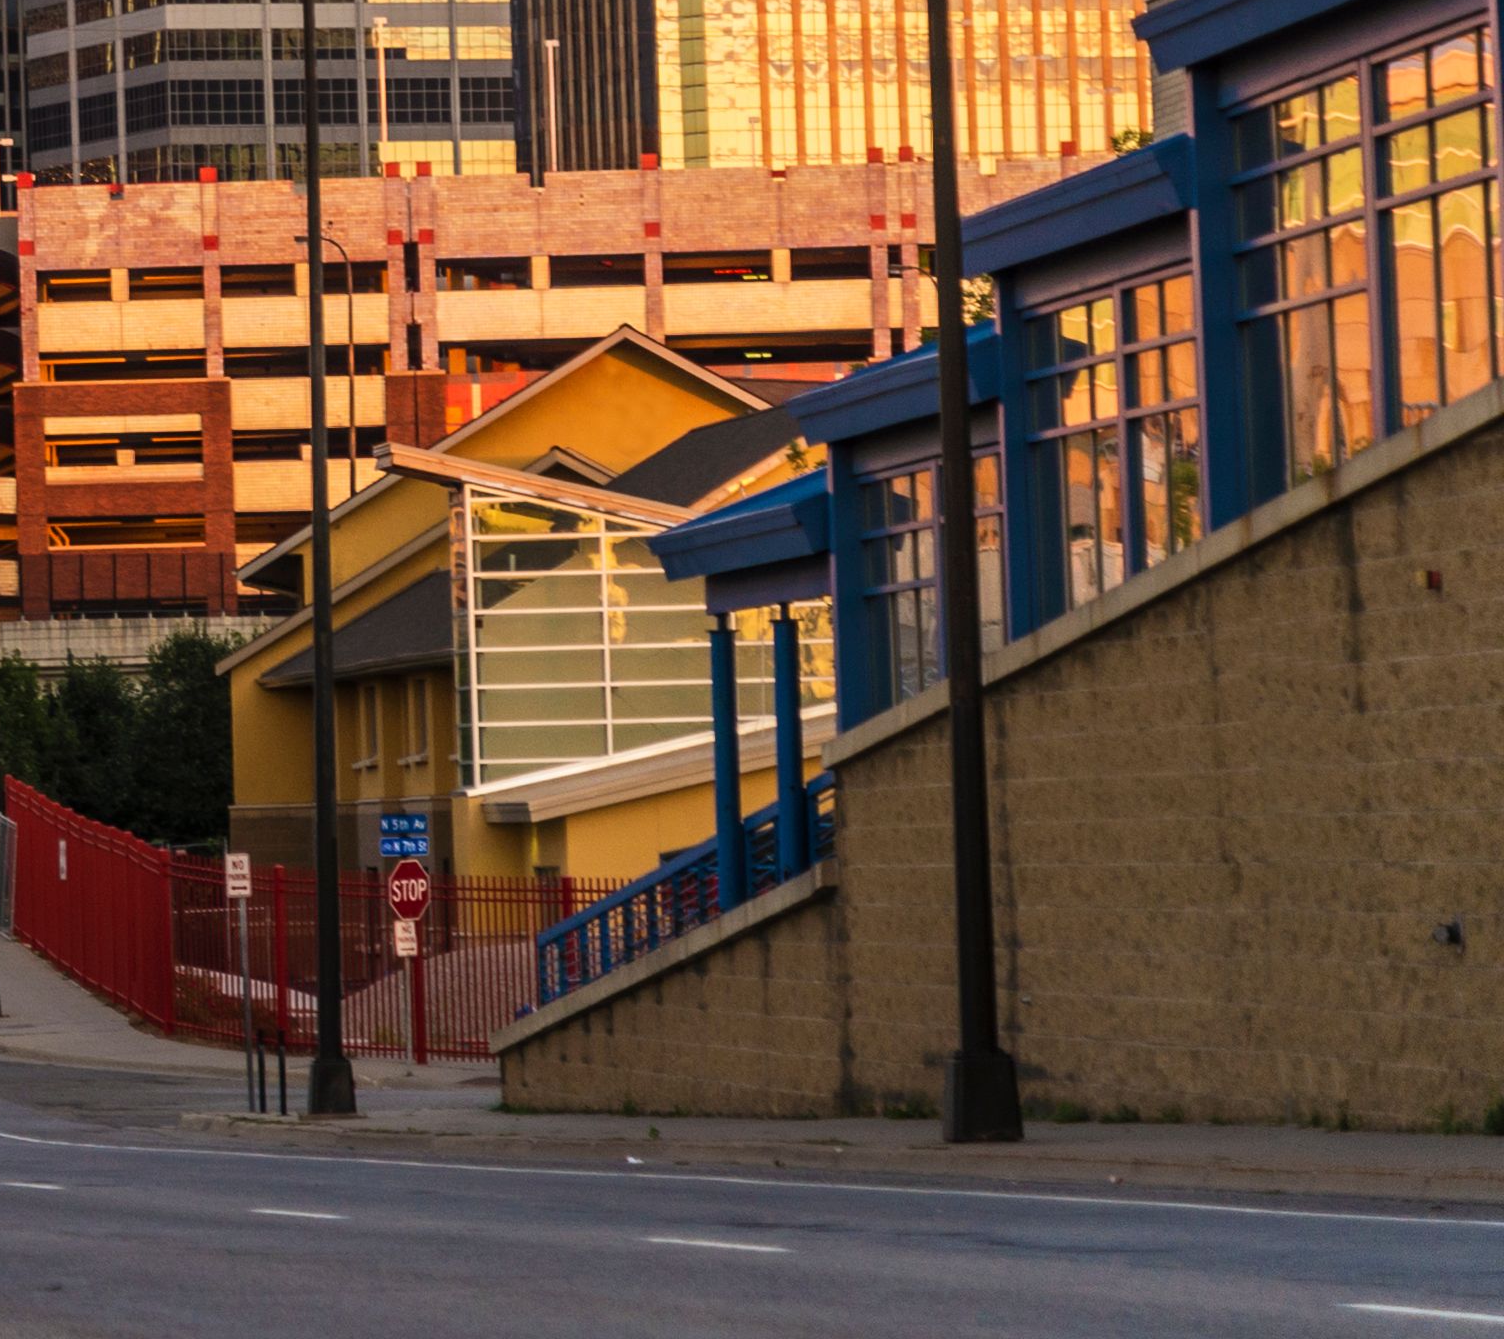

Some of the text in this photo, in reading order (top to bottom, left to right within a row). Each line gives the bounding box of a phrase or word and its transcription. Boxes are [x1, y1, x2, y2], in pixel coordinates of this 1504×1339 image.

[381, 819, 389, 830] N
[231, 859, 244, 871] NO
[392, 878, 427, 902] STOP
